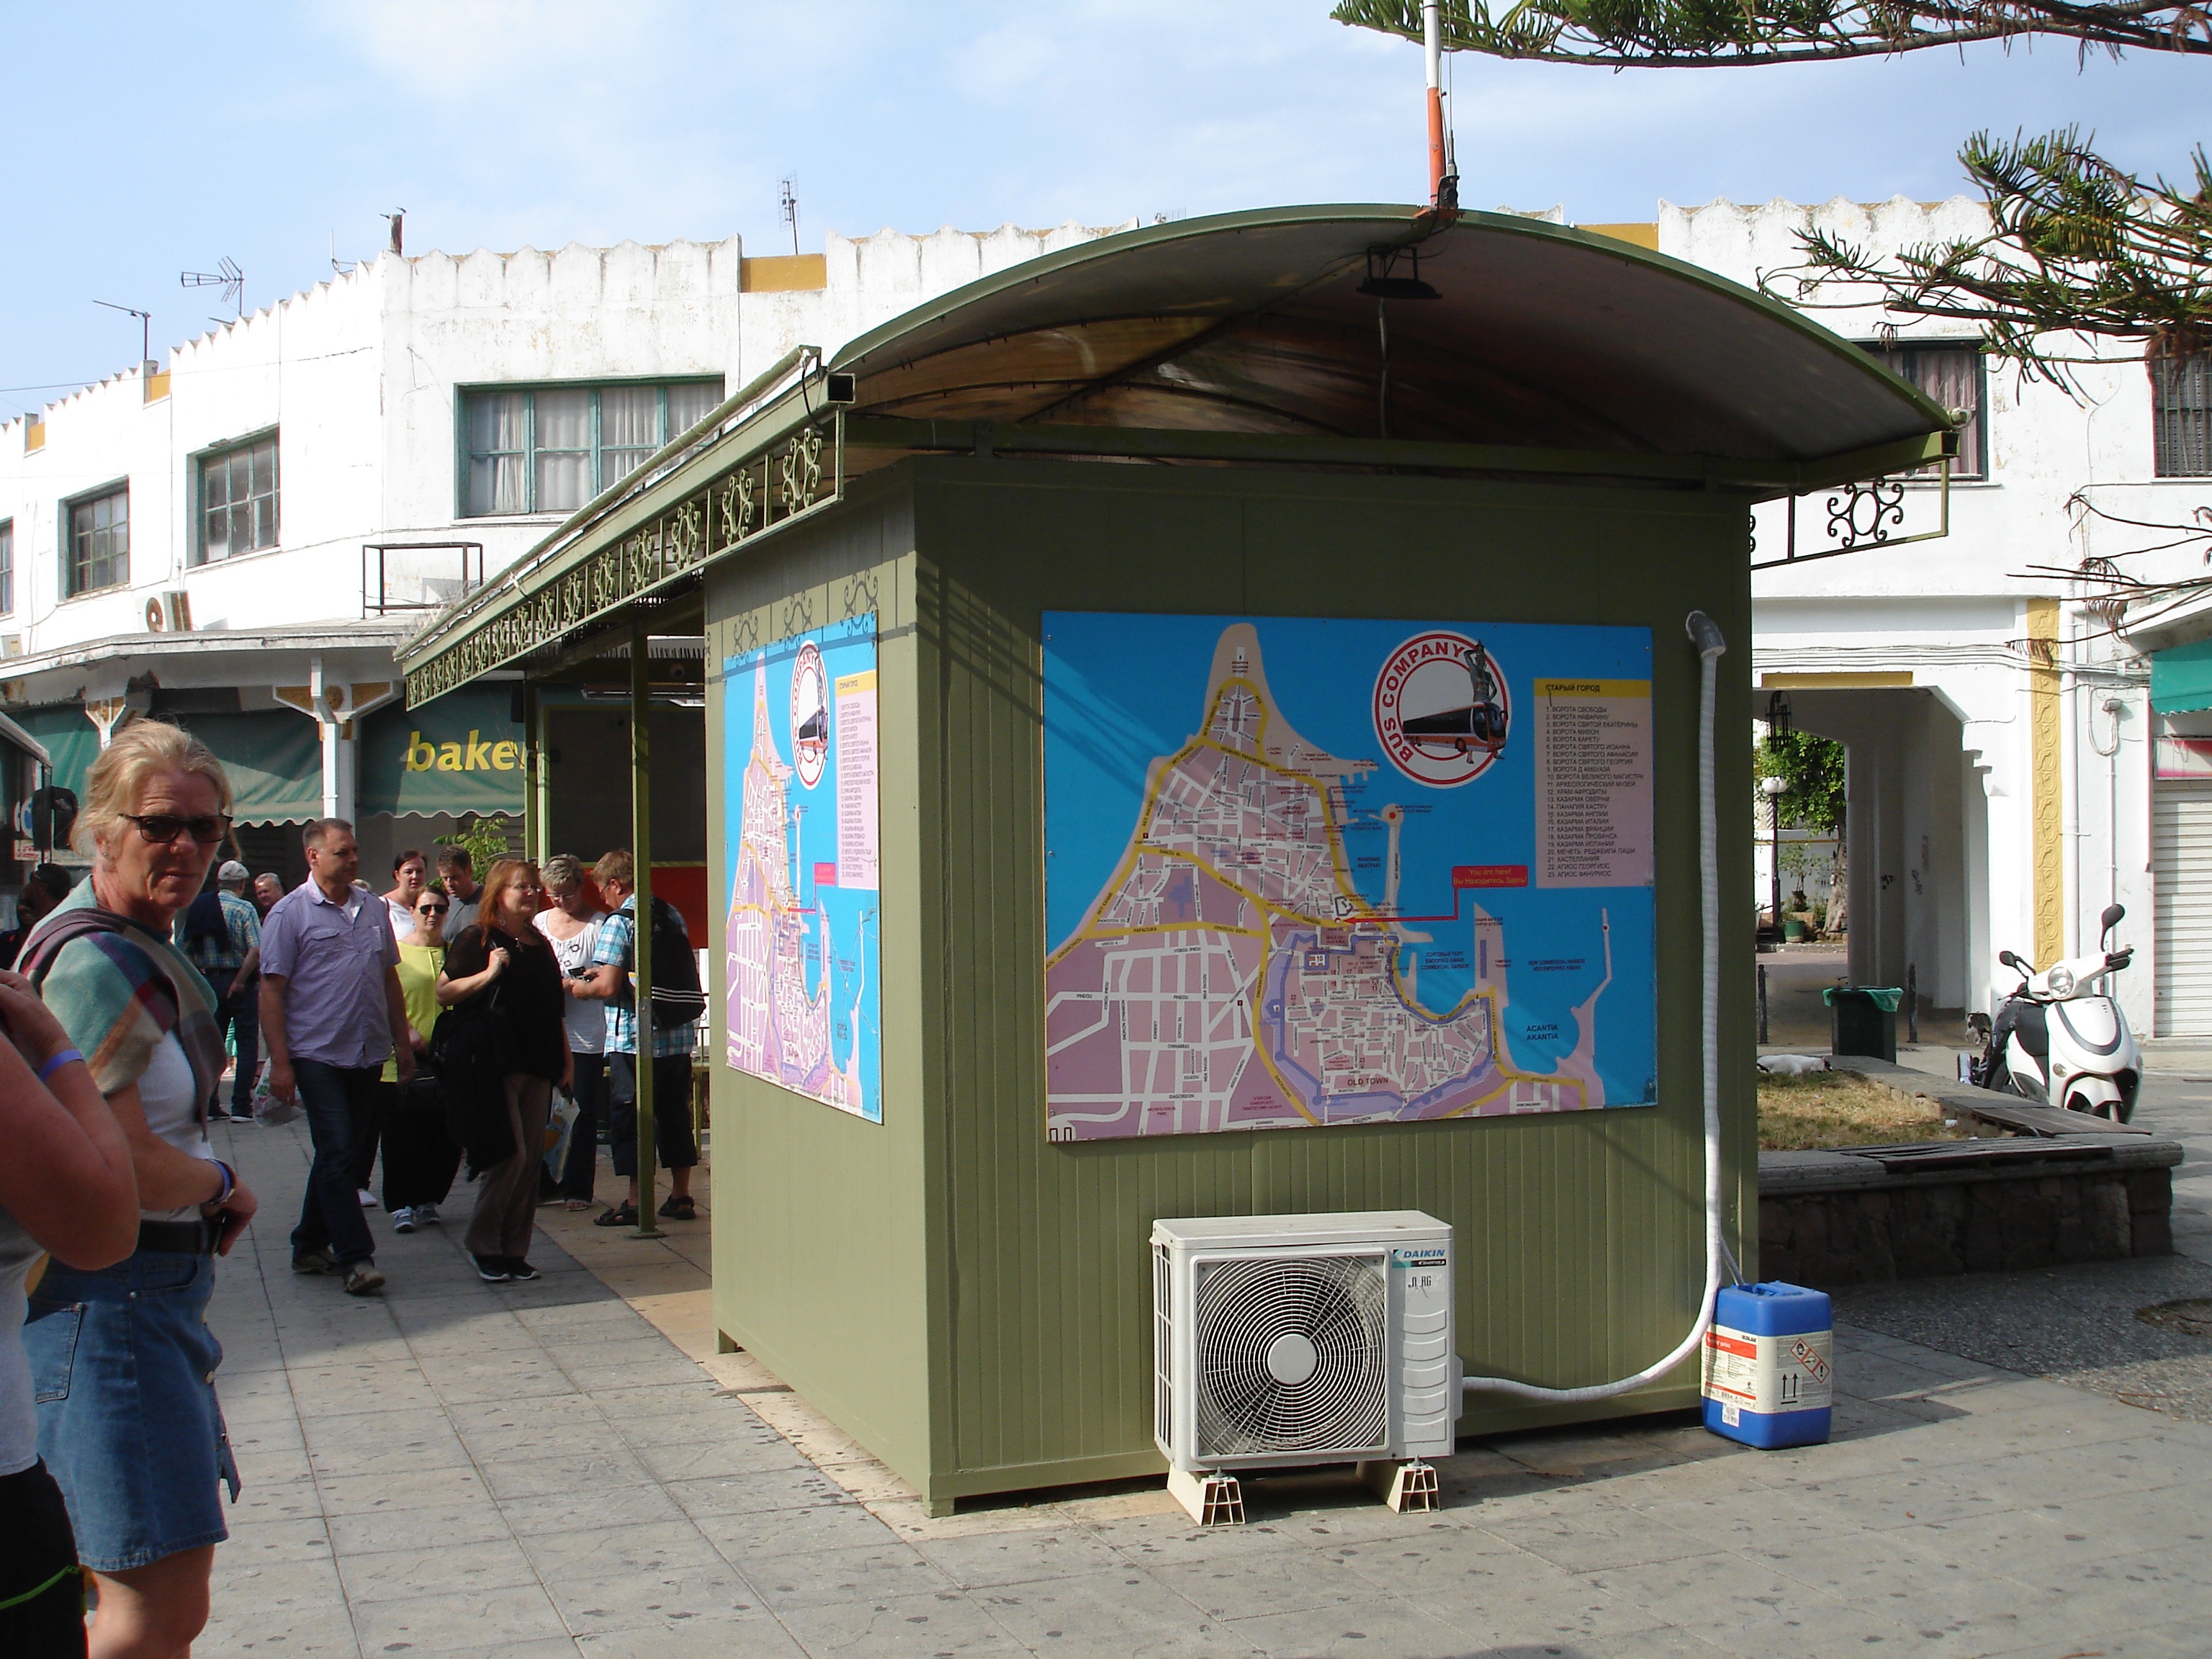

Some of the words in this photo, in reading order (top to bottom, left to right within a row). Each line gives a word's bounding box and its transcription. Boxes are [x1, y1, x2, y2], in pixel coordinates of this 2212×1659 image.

[1382, 642, 1465, 708] COMPANY
[1384, 717, 1413, 763] BUS
[1403, 1249, 1445, 1258] DAIKIN
